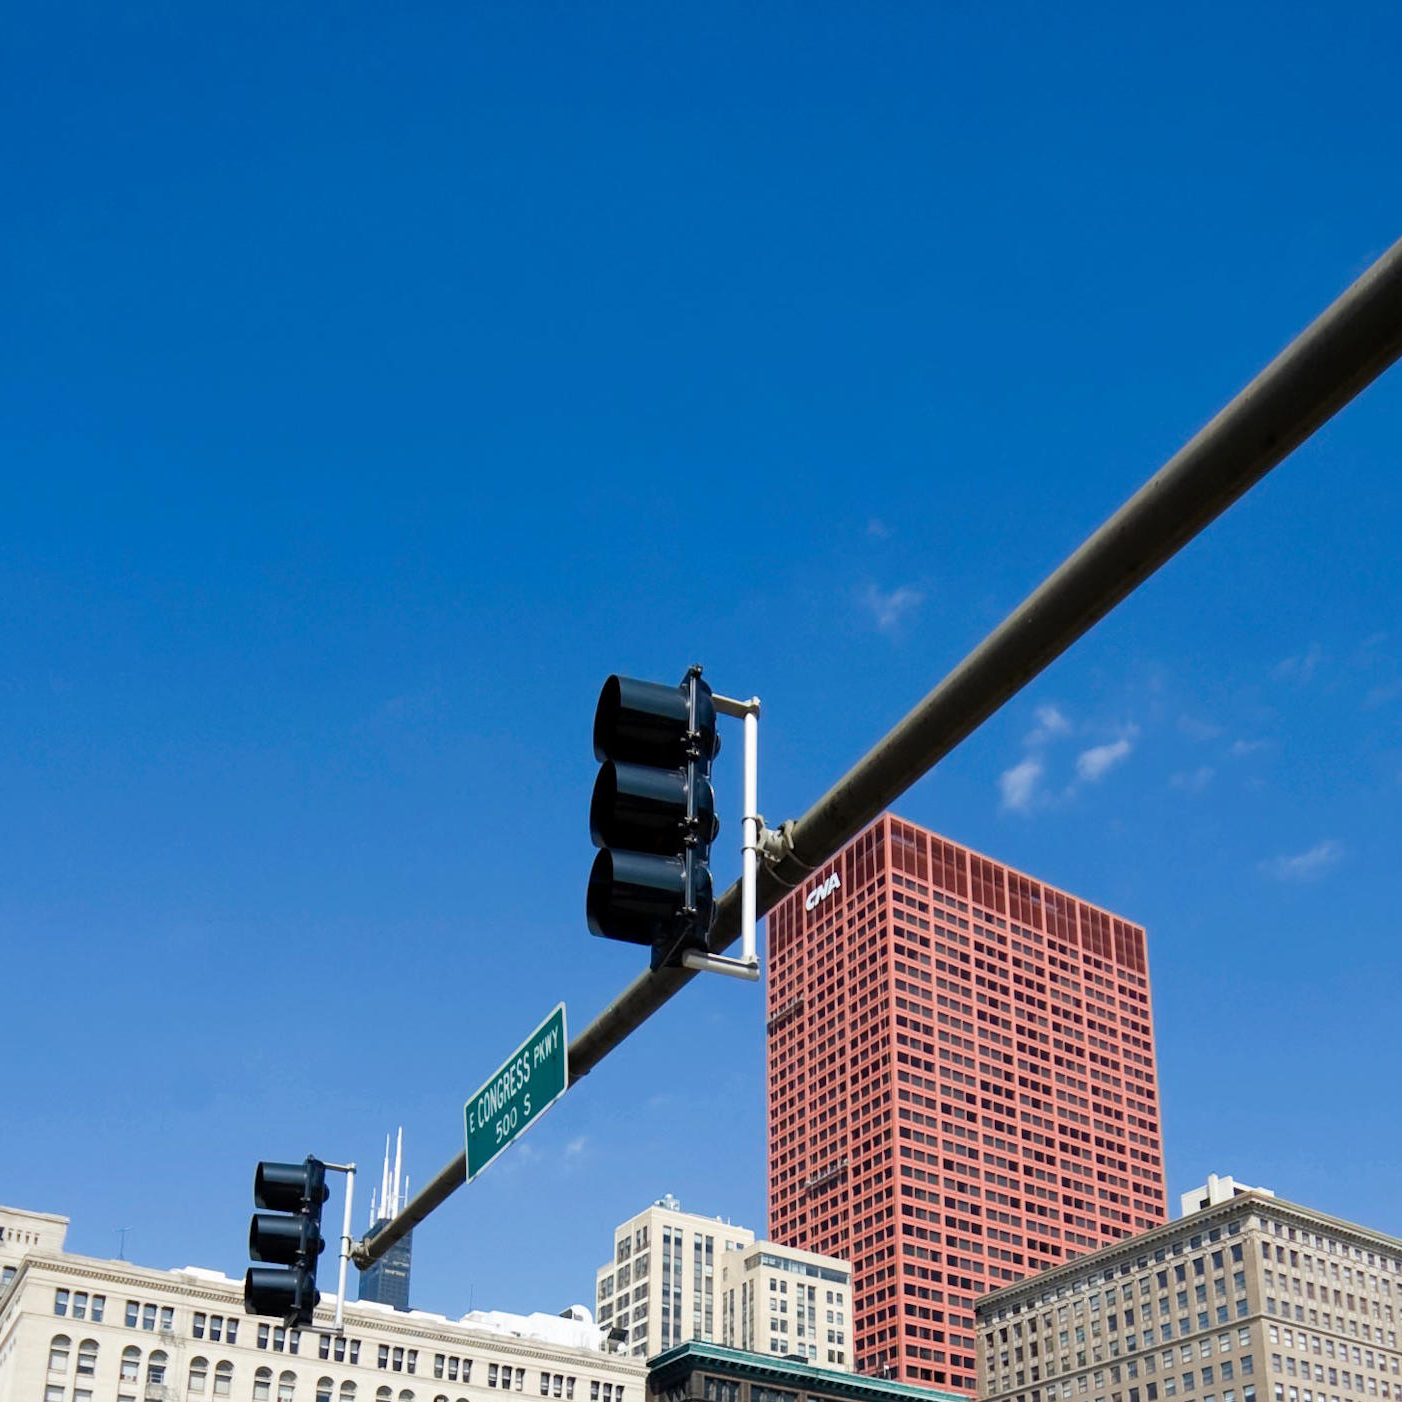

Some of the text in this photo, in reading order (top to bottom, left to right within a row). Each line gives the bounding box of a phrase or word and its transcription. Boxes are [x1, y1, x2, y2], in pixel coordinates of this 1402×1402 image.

[805, 872, 841, 911] CNA
[470, 1025, 559, 1133] E CONGRESS PKWY
[496, 1093, 532, 1144] 500 S
